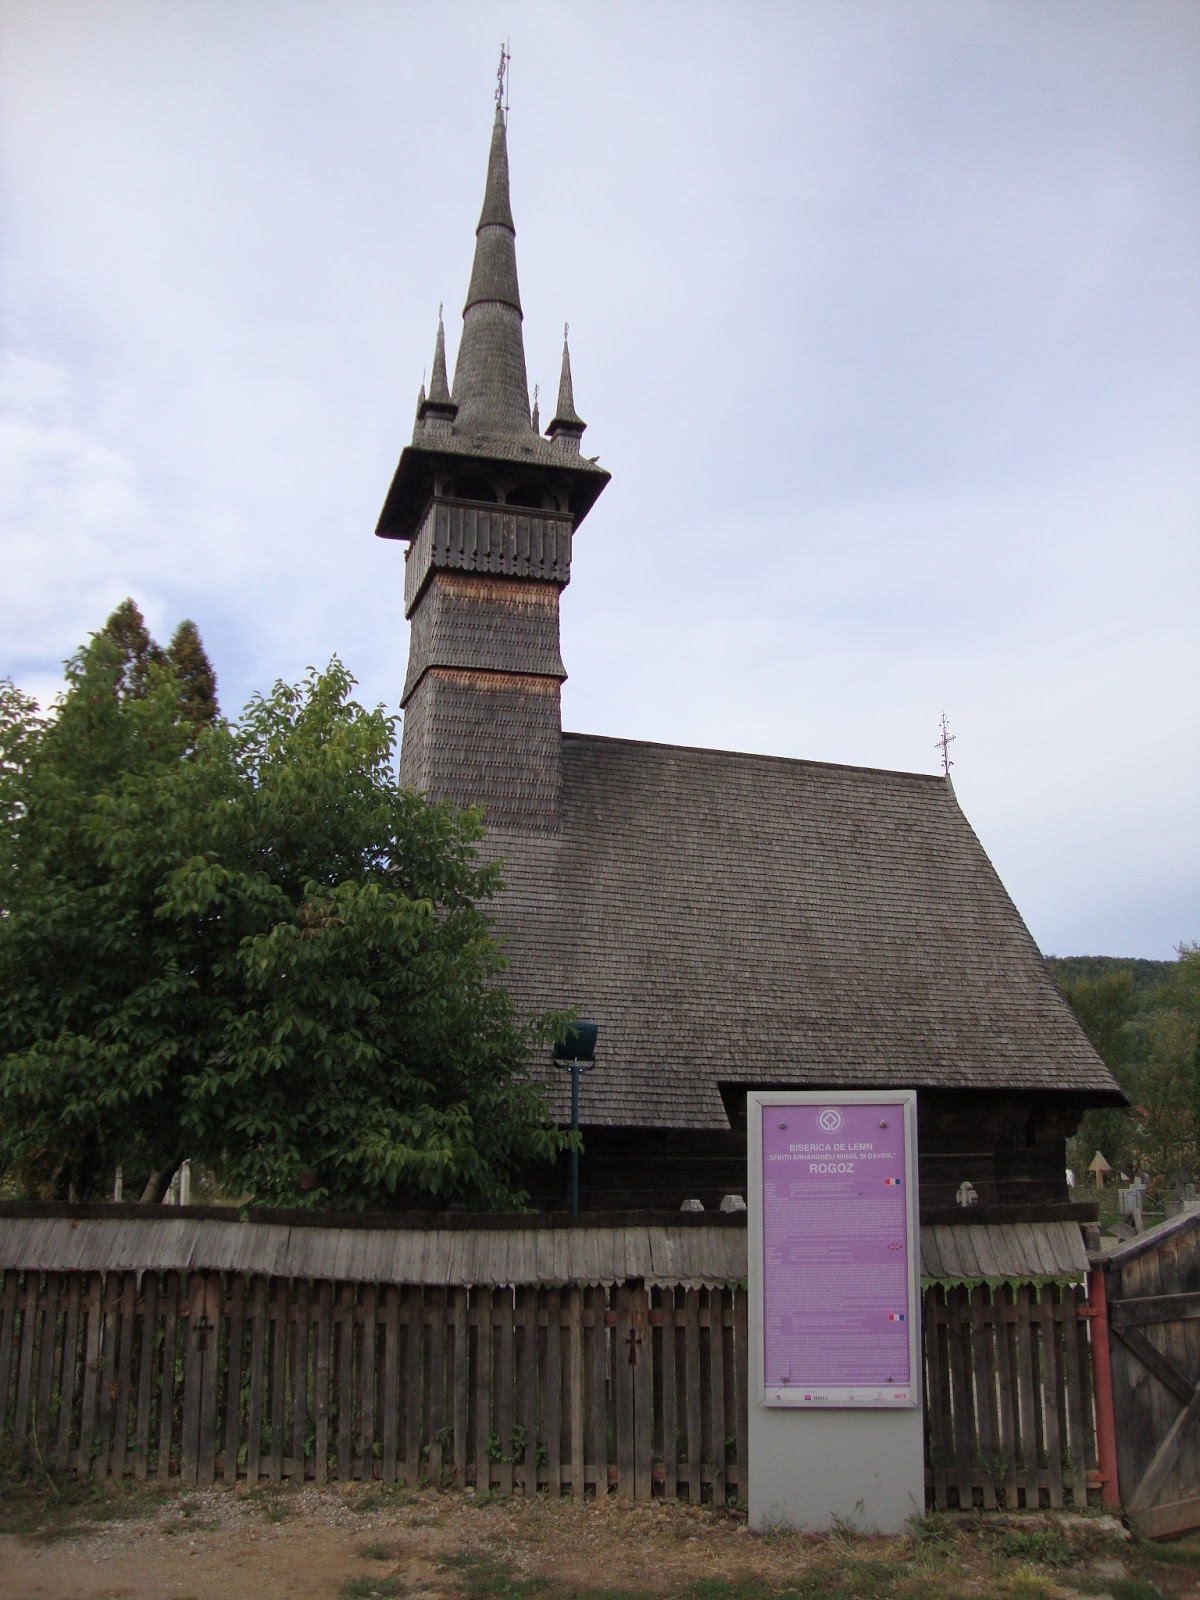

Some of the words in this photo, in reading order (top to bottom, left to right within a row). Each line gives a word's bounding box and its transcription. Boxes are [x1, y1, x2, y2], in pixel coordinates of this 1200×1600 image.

[789, 1143, 831, 1152] BISERICA
[833, 1143, 846, 1151] DE
[848, 1142, 873, 1151] LEMN
[809, 1163, 854, 1174] ROGOZ
